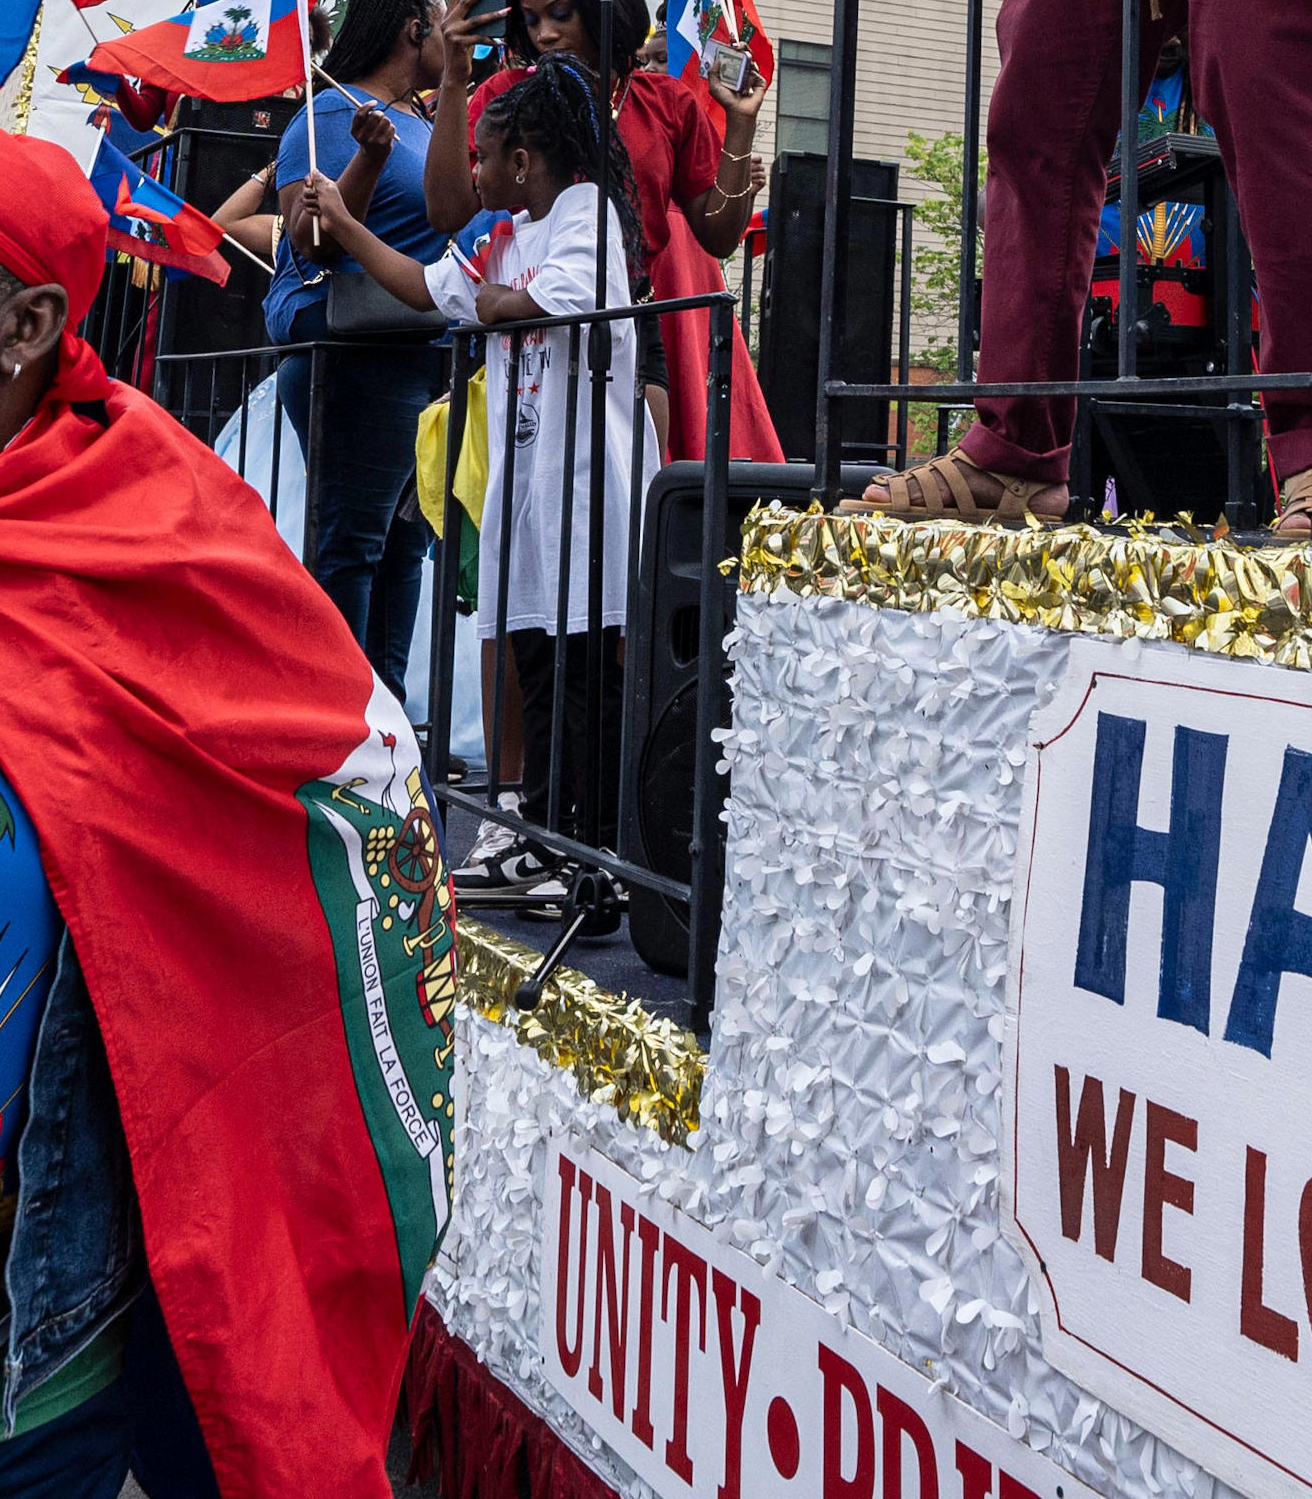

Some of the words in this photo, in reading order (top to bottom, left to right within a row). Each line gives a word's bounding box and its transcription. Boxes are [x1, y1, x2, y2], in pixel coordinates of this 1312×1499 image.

[358, 916, 379, 992] L'UNION
[369, 998, 389, 1039] FAIT
[379, 1046, 397, 1075] LA
[390, 1077, 429, 1149] FORCE
[1054, 1064, 1198, 1304] WE
[556, 1152, 761, 1499] UNITY
